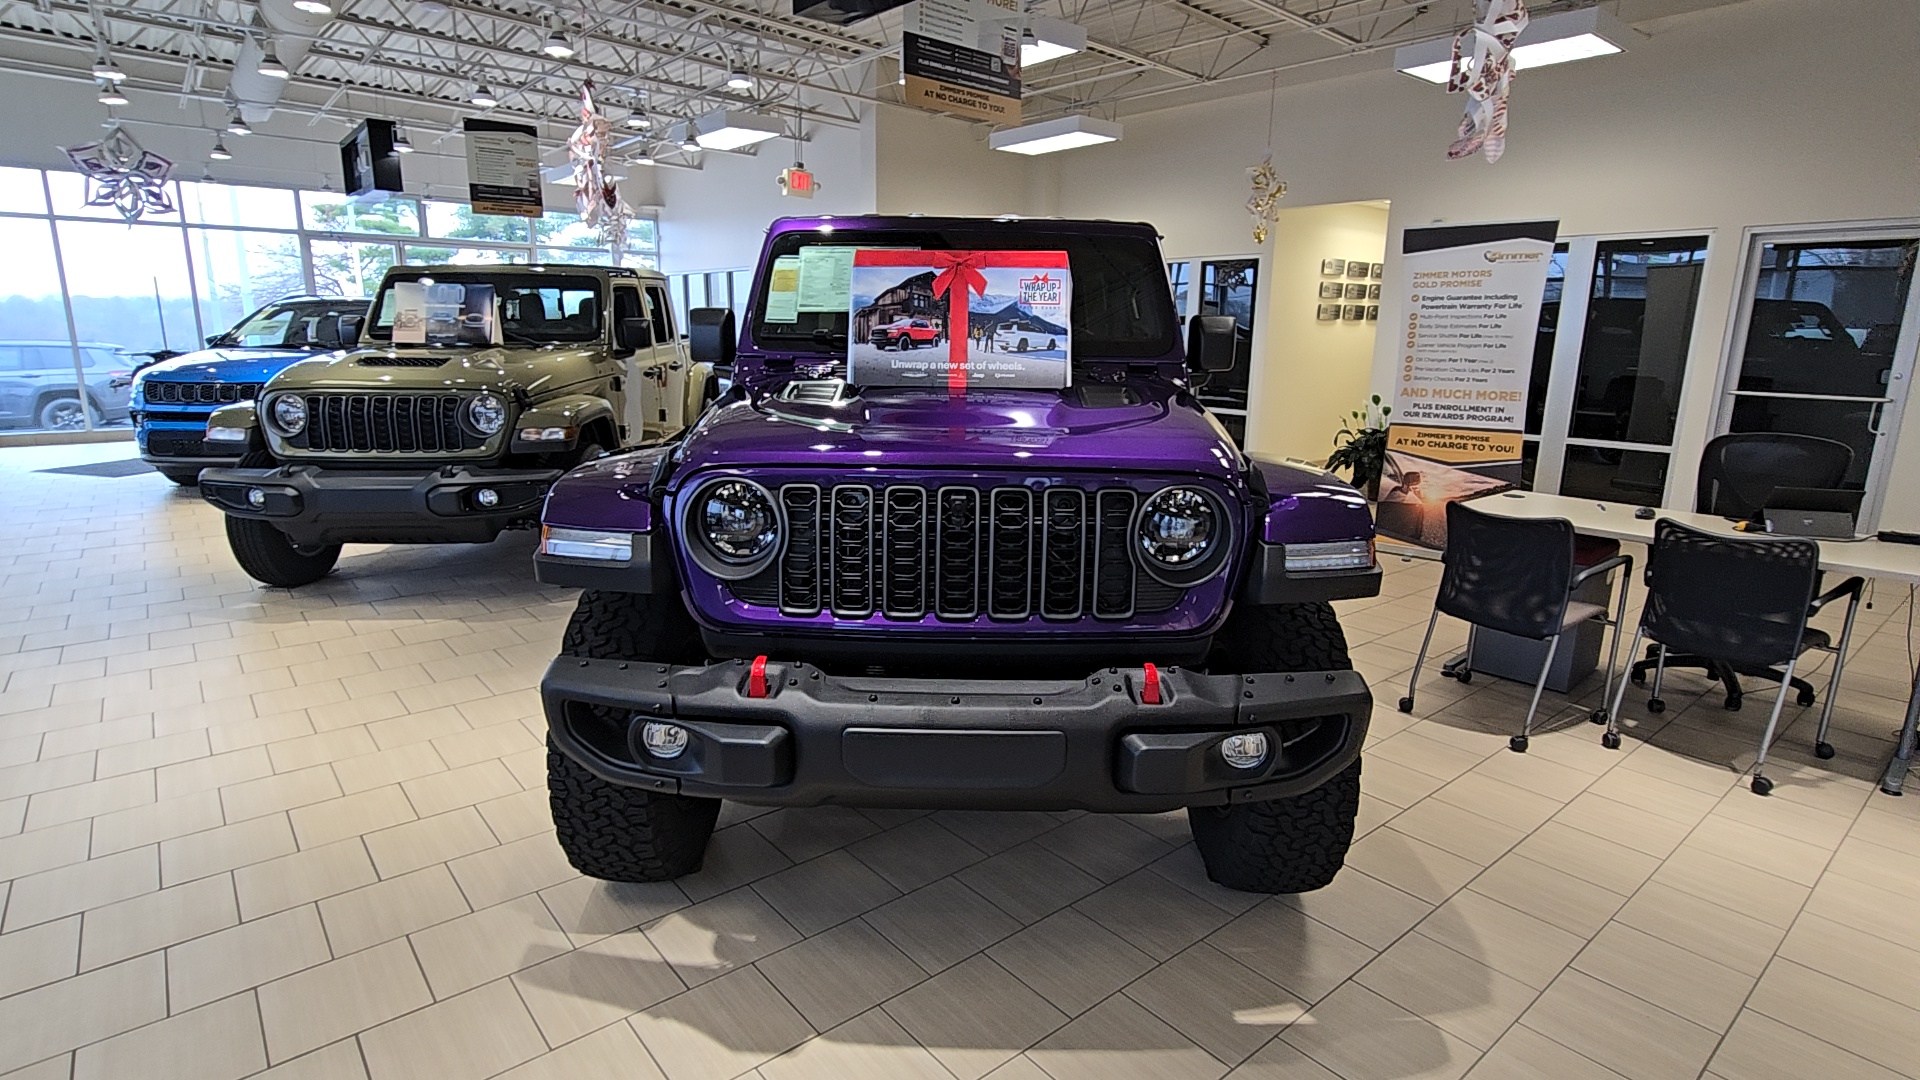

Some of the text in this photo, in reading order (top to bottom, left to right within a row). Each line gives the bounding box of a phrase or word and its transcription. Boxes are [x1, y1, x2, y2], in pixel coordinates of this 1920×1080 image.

[924, 89, 934, 97] AT
[936, 92, 946, 100] NO
[948, 95, 977, 108] CHARGE
[978, 101, 988, 110] TO
[1413, 270, 1493, 279] ZIMMER MOTORS
[1024, 282, 1056, 292] WRAP UP
[1024, 292, 1057, 302] THE YEAR
[891, 360, 928, 371] Unwrap
[960, 361, 975, 370] set
[976, 360, 987, 370] of
[988, 361, 1026, 371] wheels.
[1400, 387, 1522, 402] AND MUCH MORE!
[1435, 404, 1493, 413] ENROLLMENT
[1422, 412, 1465, 420] REWARDS
[1466, 414, 1514, 423] PROGRAM!
[1417, 432, 1490, 442] ZIMMER'S PROMISE
[1427, 441, 1468, 450] CHARGE
[1488, 445, 1514, 453] YOU!
